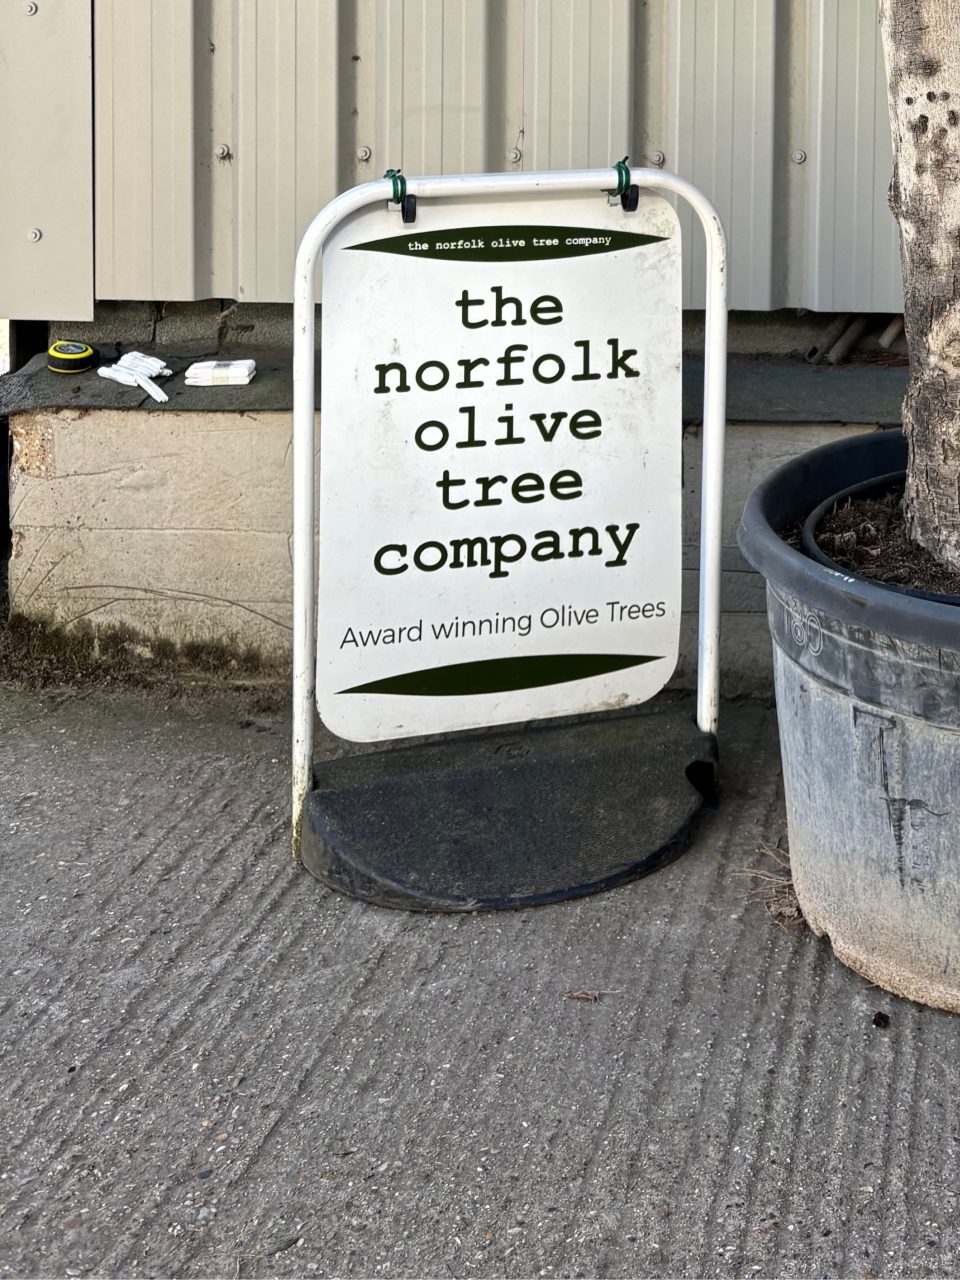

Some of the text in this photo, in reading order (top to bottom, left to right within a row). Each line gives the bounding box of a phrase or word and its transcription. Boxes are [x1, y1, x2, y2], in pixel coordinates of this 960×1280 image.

[407, 236, 612, 251] the norfolk olive tree company
[456, 286, 562, 328] the
[374, 339, 640, 393] norfolk
[415, 404, 601, 451] olive
[436, 470, 582, 509] tree
[374, 523, 639, 578] company
[340, 602, 665, 648] Award winning Olive Trees
